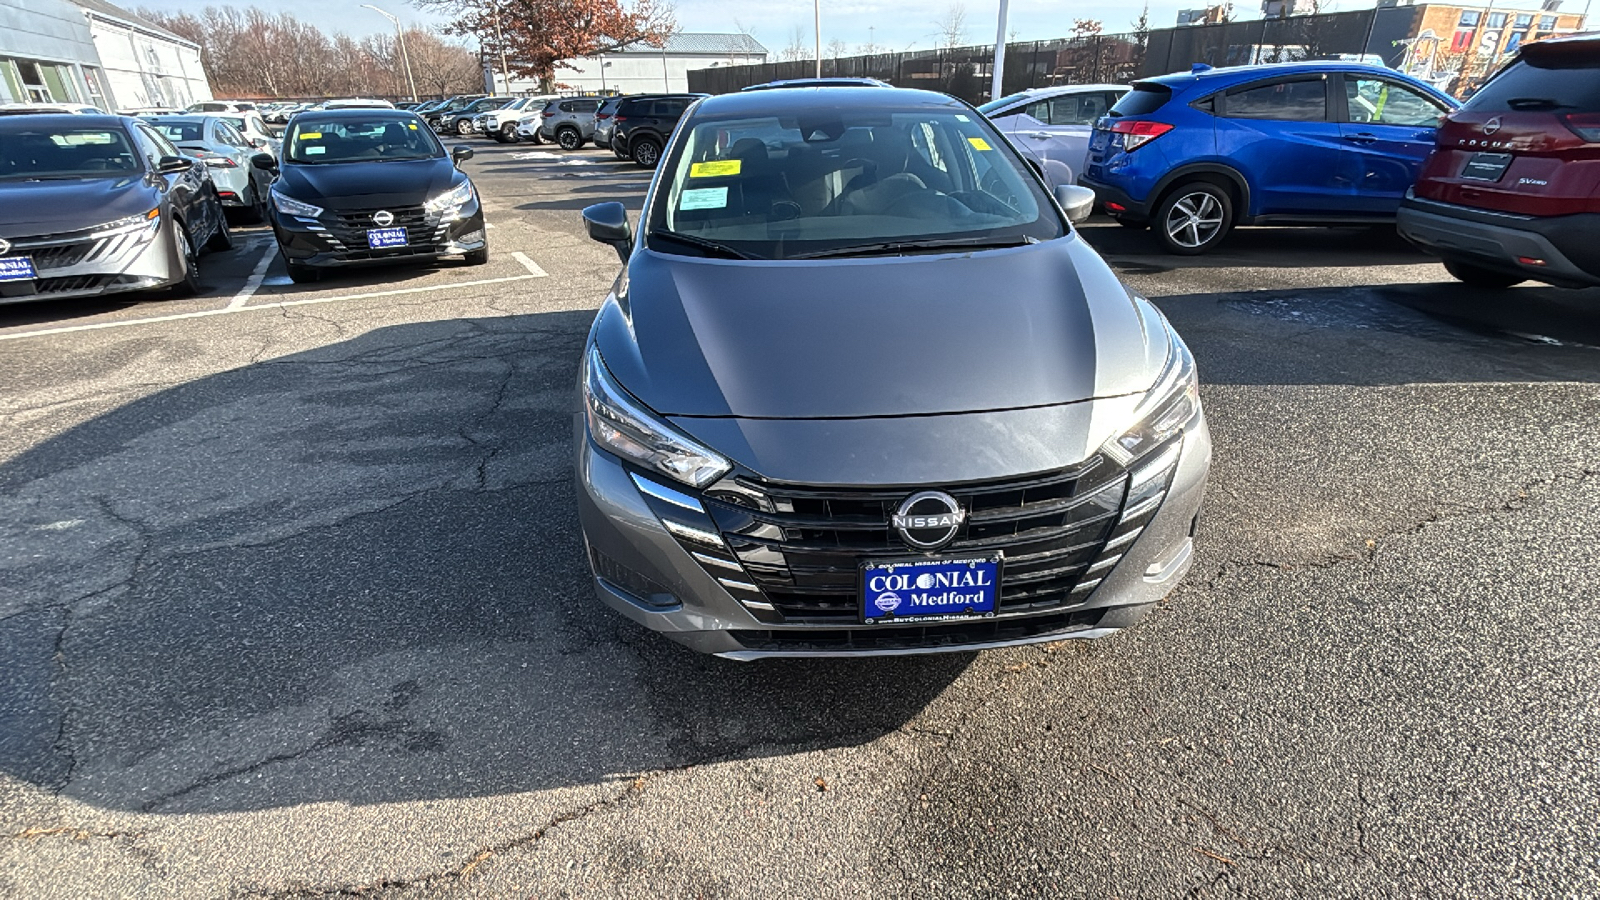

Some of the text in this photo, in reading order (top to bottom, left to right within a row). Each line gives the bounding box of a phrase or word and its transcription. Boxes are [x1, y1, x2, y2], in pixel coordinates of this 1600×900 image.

[1459, 139, 1513, 149] ROGUE
[369, 231, 405, 239] COLONIAL
[893, 513, 963, 528] NISSAN
[869, 570, 992, 592] COLONIAL
[910, 590, 985, 607] Medford
